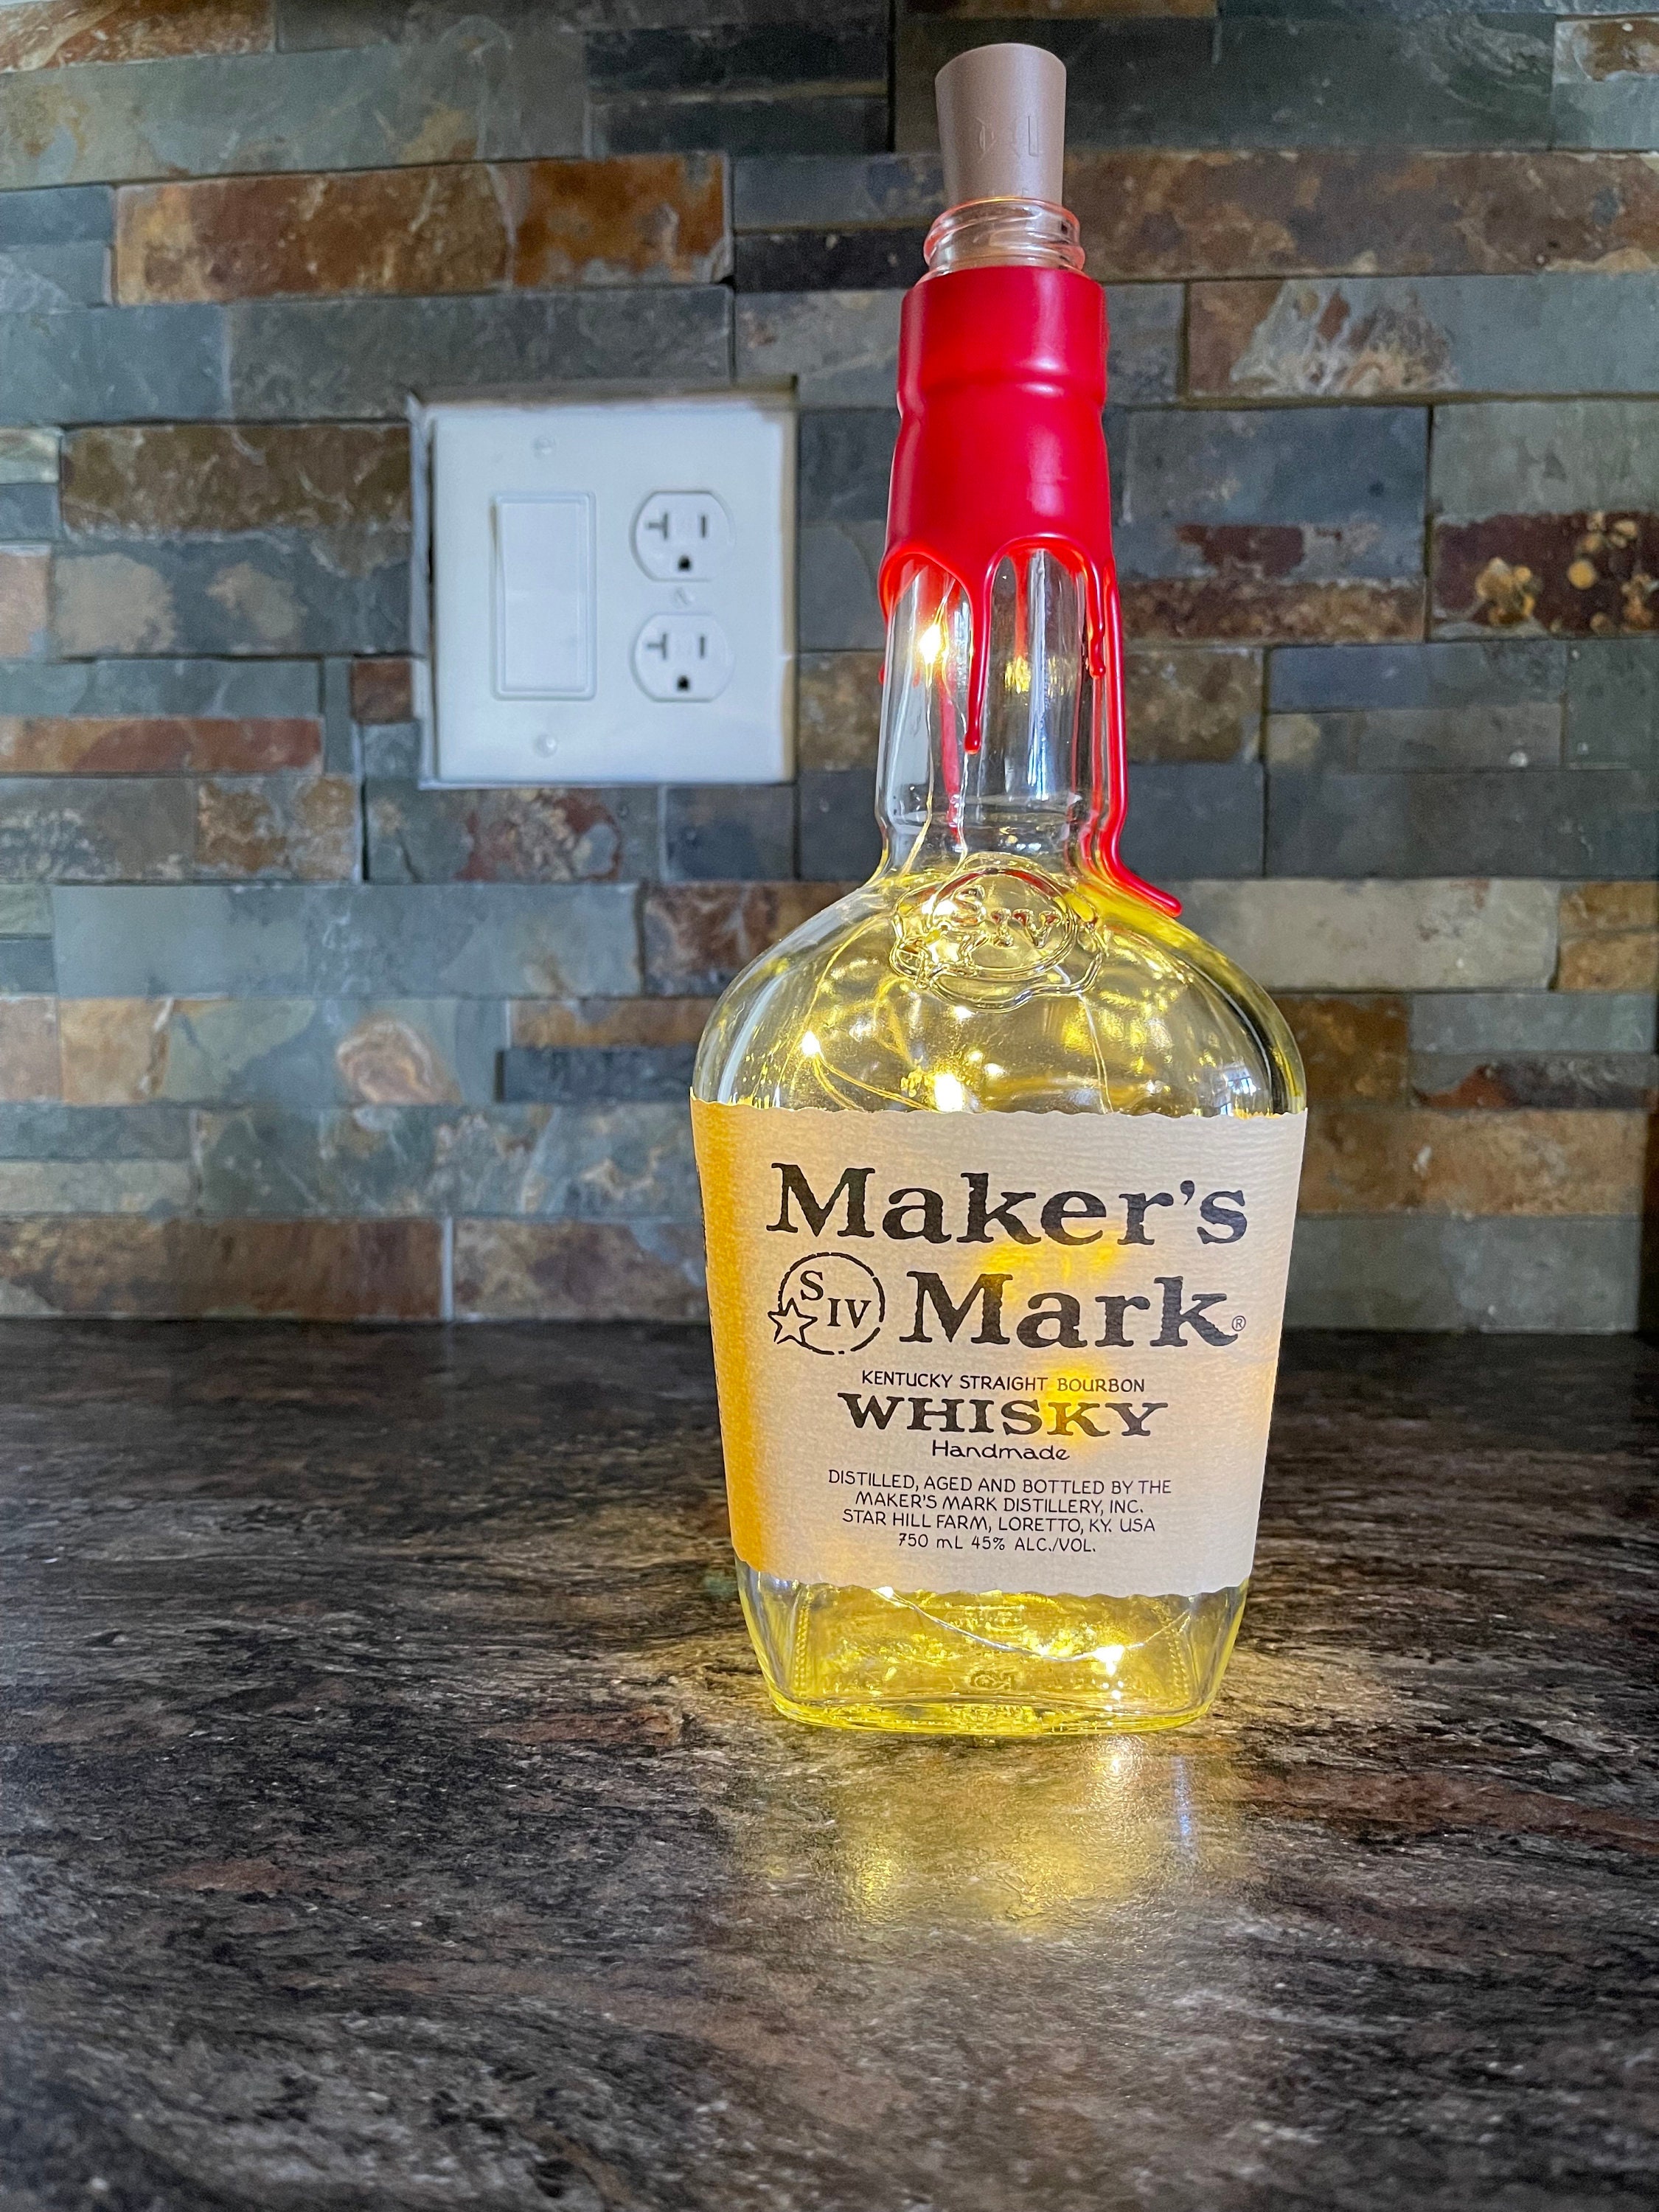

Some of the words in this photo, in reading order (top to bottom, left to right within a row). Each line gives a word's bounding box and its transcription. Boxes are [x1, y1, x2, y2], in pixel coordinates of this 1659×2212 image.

[765, 1162, 1248, 1246] Maker's
[799, 1270, 824, 1301] S
[827, 1297, 872, 1329] IV
[862, 1369, 953, 1388] KENTUCKY
[959, 1374, 1048, 1391] STRAIGHT
[1057, 1377, 1145, 1393] BOURBON
[837, 1392, 1169, 1437] WHISKY
[932, 1439, 1071, 1461] Handmade
[828, 1469, 919, 1493] DISTILLED,
[923, 1475, 973, 1492] AGED
[978, 1478, 1016, 1493] AND
[1022, 1478, 1105, 1495] BOTTLED
[1111, 1480, 1133, 1495] BY
[1138, 1480, 1172, 1495] THE
[855, 1491, 937, 1509] MAKER'S
[942, 1495, 998, 1512] MARK
[1004, 1498, 1104, 1517] DISTILLERY,
[1110, 1499, 1144, 1514] INC.
[842, 1509, 886, 1526] STAR
[892, 1512, 931, 1528] HILL
[936, 1514, 992, 1534] FARM,
[998, 1516, 1084, 1535] LORETTO,
[1089, 1518, 1112, 1533] KY.
[1120, 1517, 1155, 1533] USA
[899, 1532, 928, 1548] 750
[936, 1535, 964, 1550] mL
[971, 1535, 1005, 1551] 45%
[1014, 1537, 1096, 1553] ALC./VOL.
